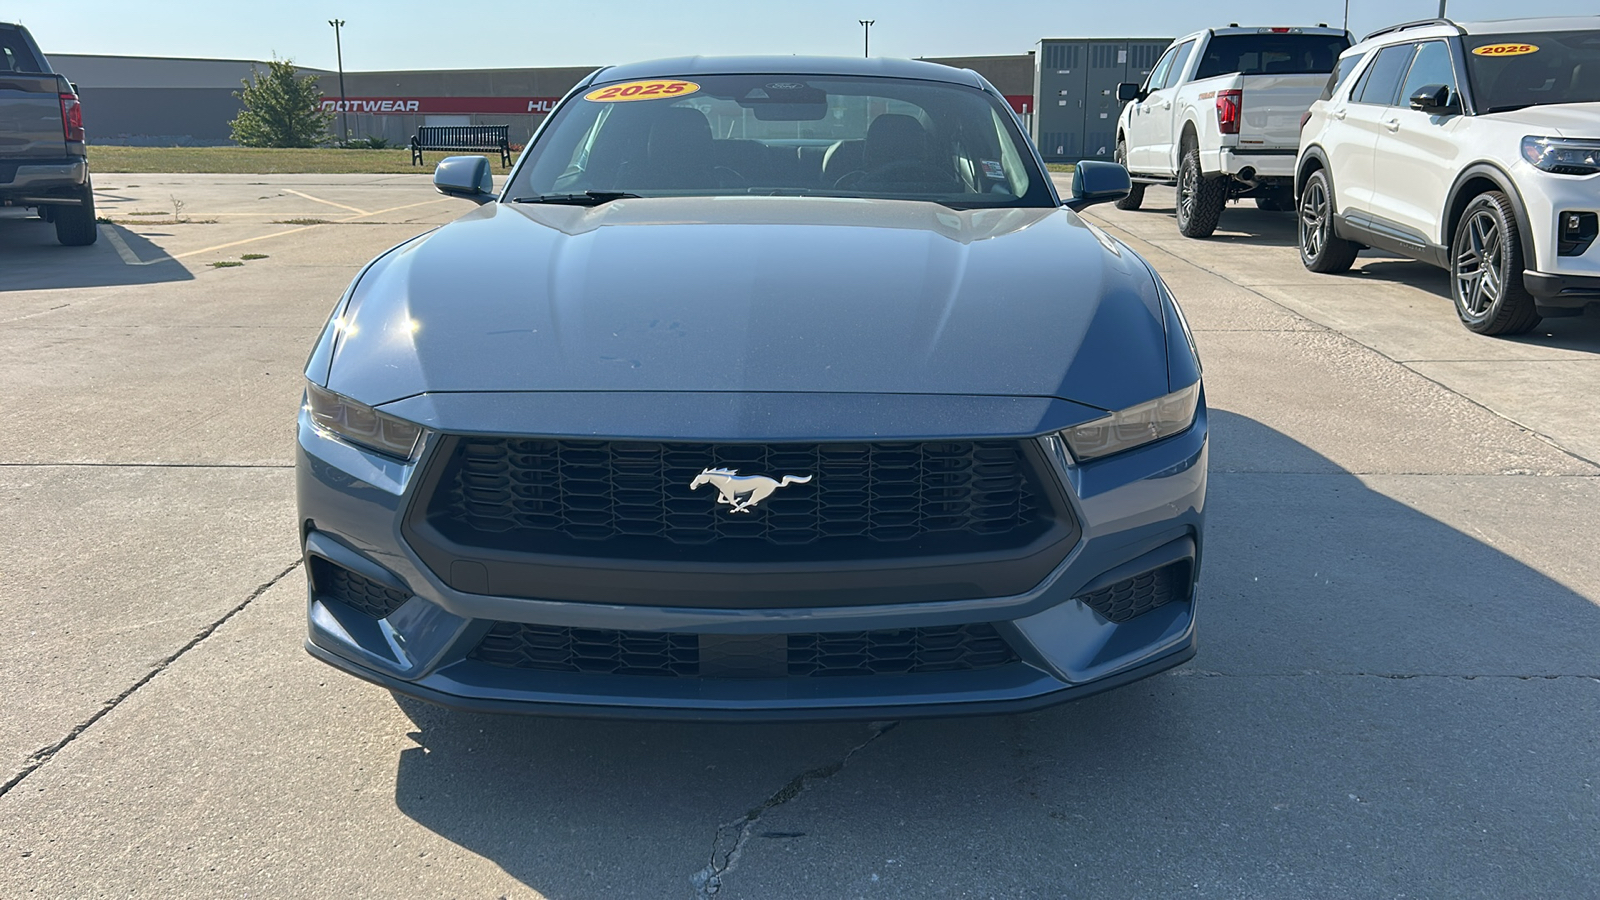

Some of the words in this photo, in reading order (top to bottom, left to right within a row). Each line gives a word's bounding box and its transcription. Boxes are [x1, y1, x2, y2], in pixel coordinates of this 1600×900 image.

[1481, 45, 1531, 54] 2025
[597, 82, 688, 99] 2025
[311, 100, 419, 112] OOTWEAR
